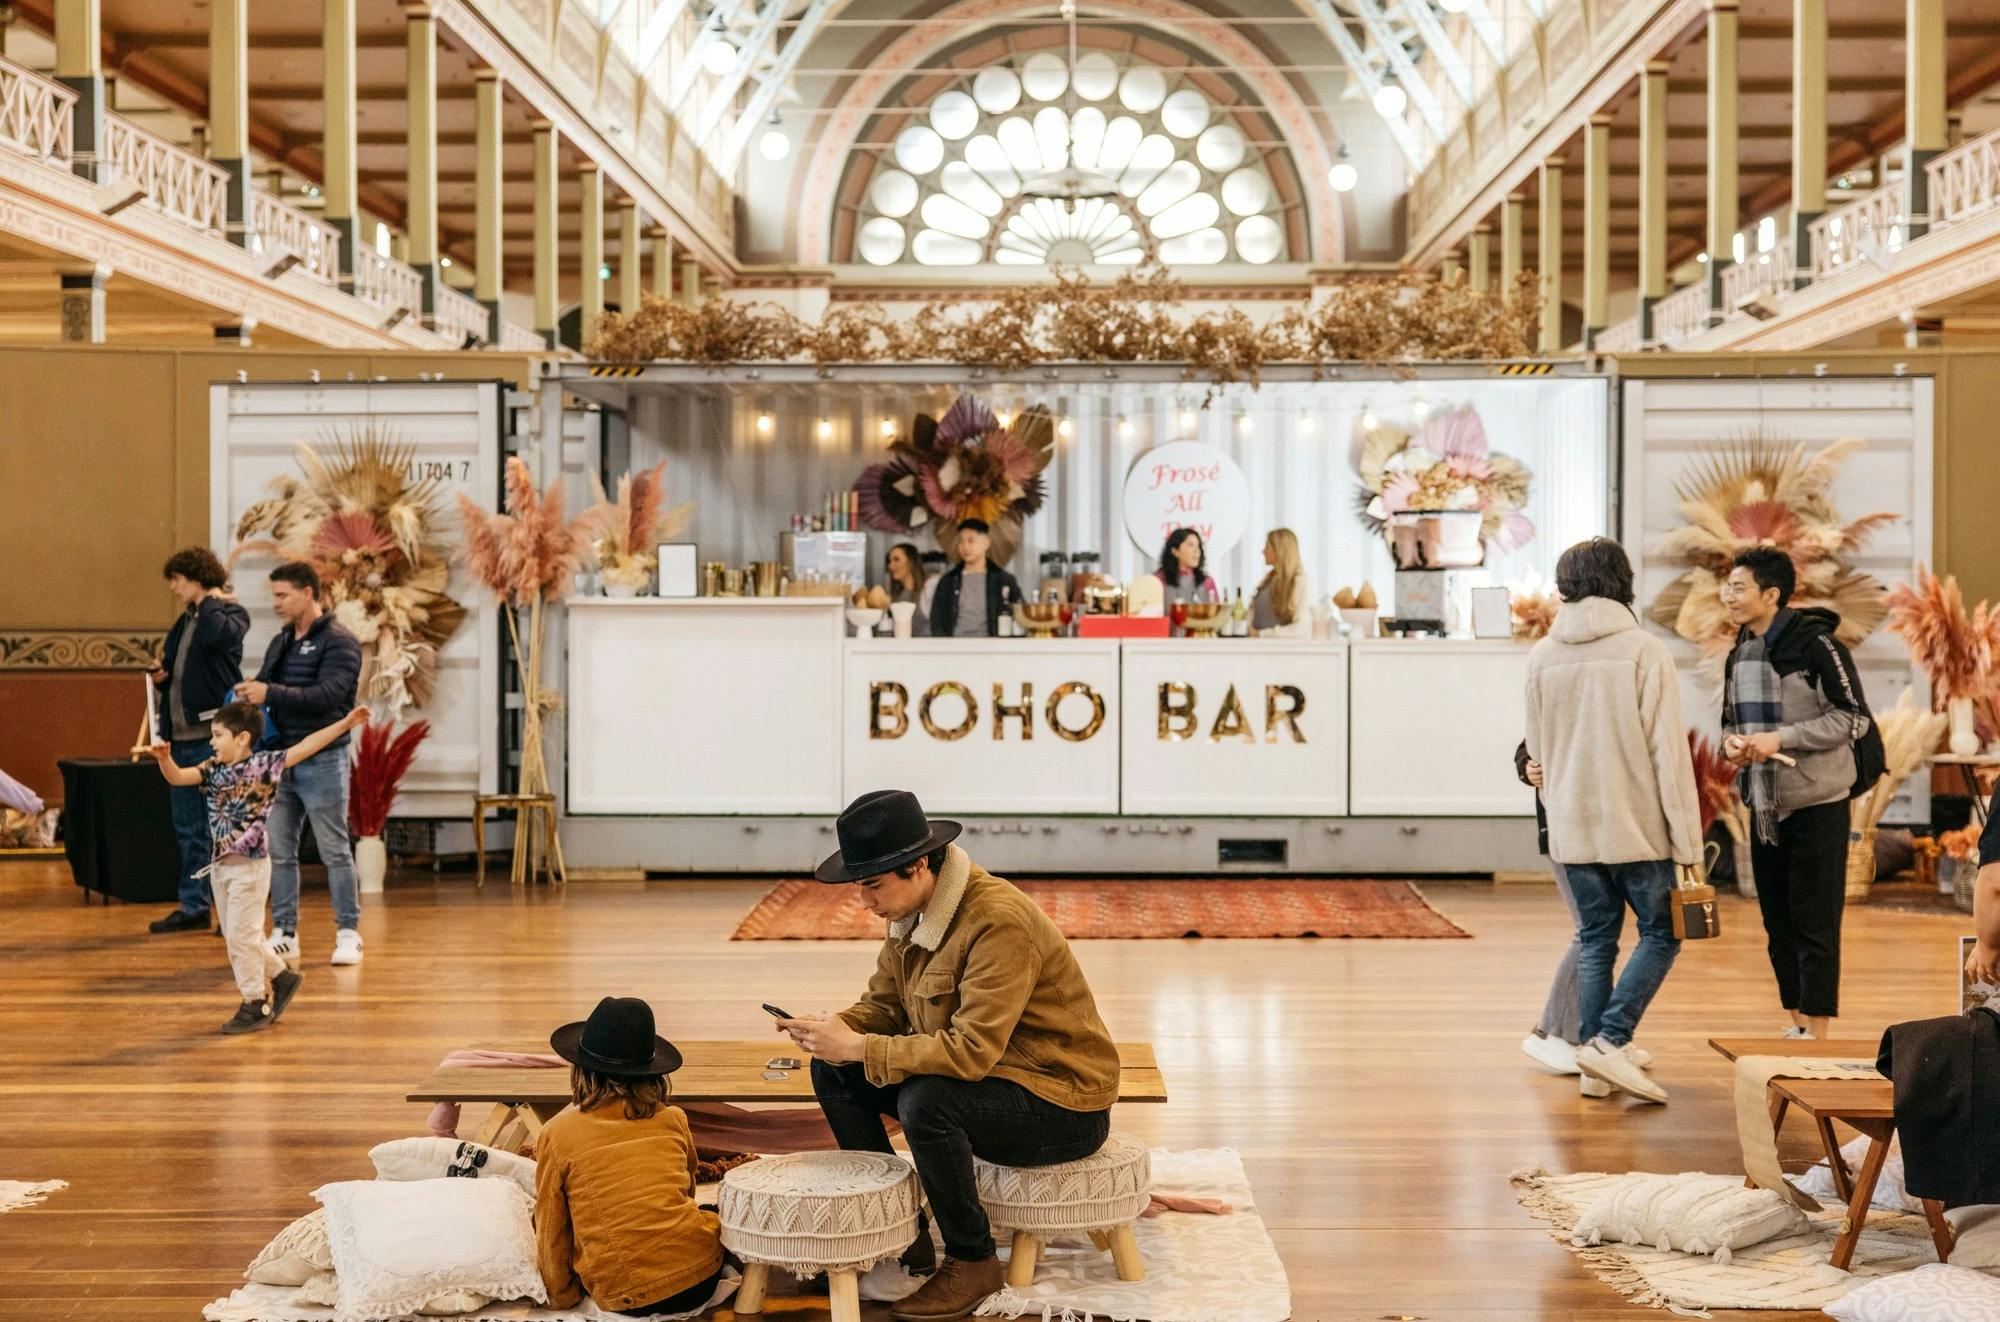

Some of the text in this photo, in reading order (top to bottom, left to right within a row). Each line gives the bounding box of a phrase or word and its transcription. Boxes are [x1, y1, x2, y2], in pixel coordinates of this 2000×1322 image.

[461, 461, 471, 481] 7
[1164, 490, 1209, 514] All
[868, 680, 1308, 744] BOHO BAR
